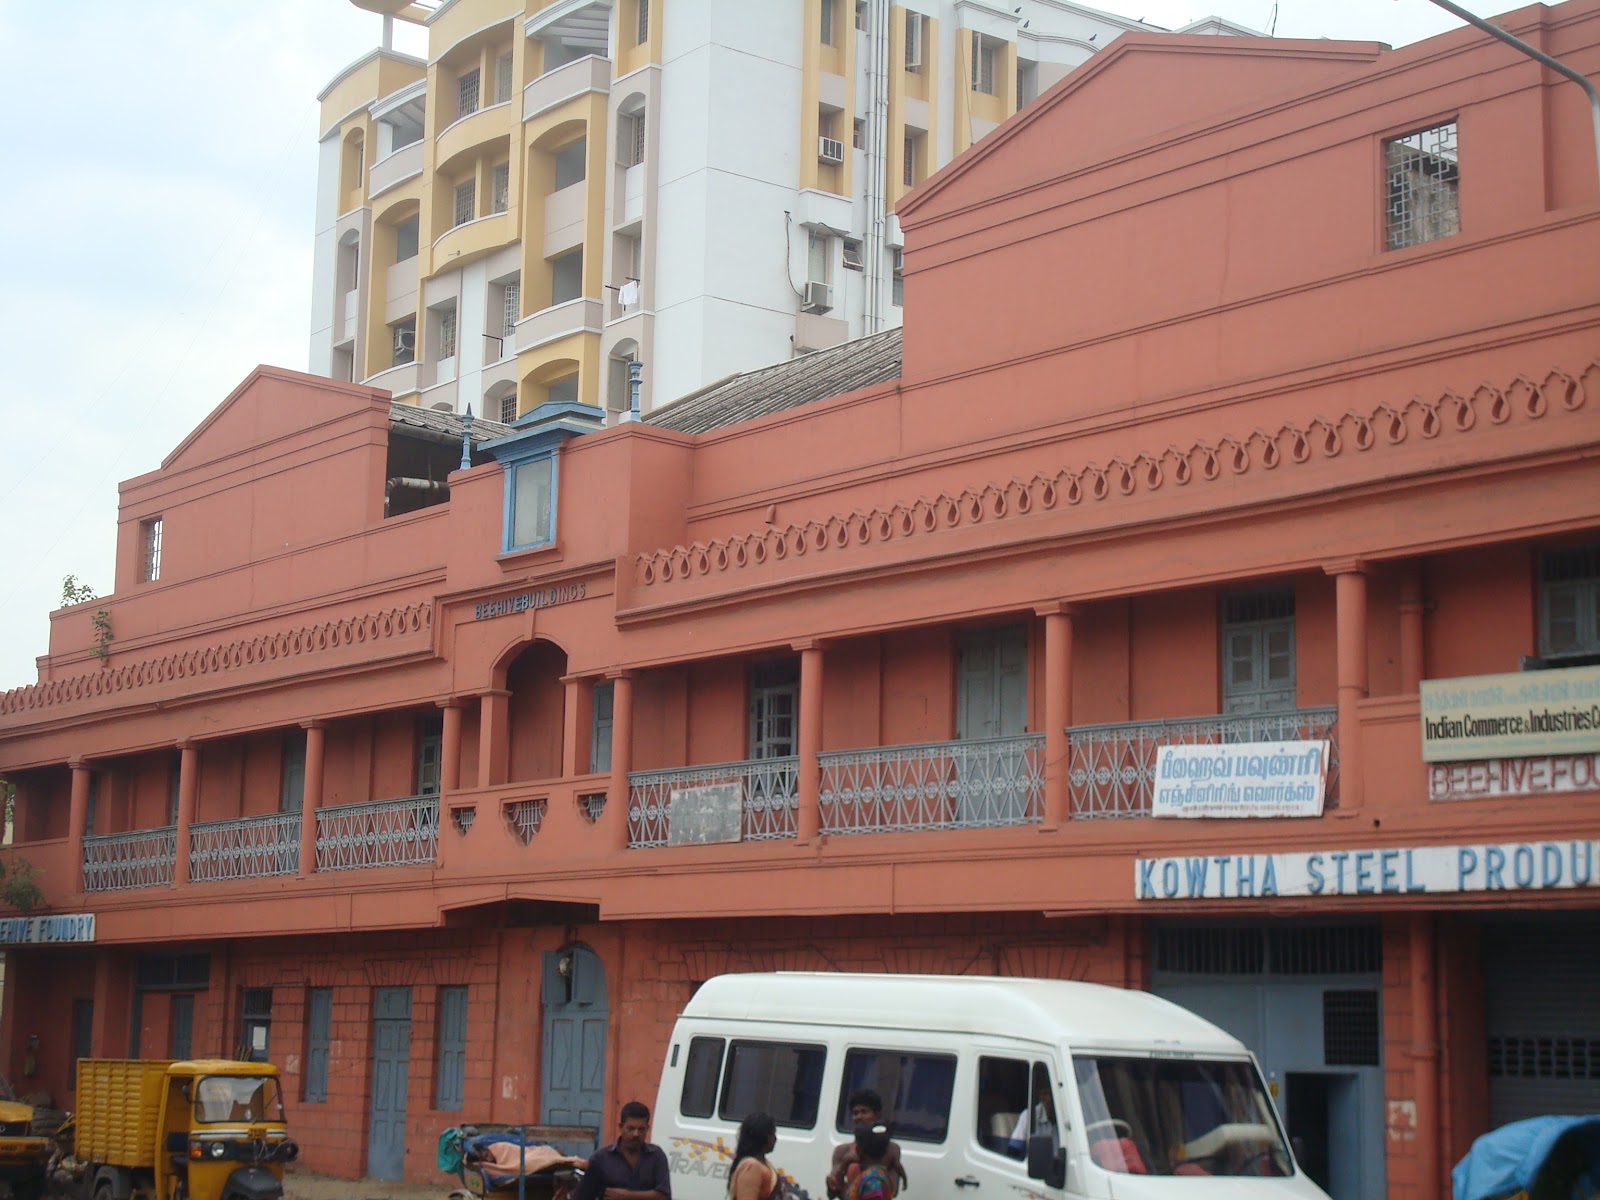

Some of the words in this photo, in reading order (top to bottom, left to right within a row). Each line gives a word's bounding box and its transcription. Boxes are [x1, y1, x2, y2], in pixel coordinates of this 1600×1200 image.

[1425, 715, 1464, 741] Indian
[1464, 714, 1523, 738] Commerce
[1529, 706, 1591, 733] Industries
[1431, 757, 1547, 797] BEEHIVE
[1139, 855, 1279, 899] KOWTHA
[1306, 850, 1426, 894] STEEL
[1457, 840, 1592, 889] PRODU
